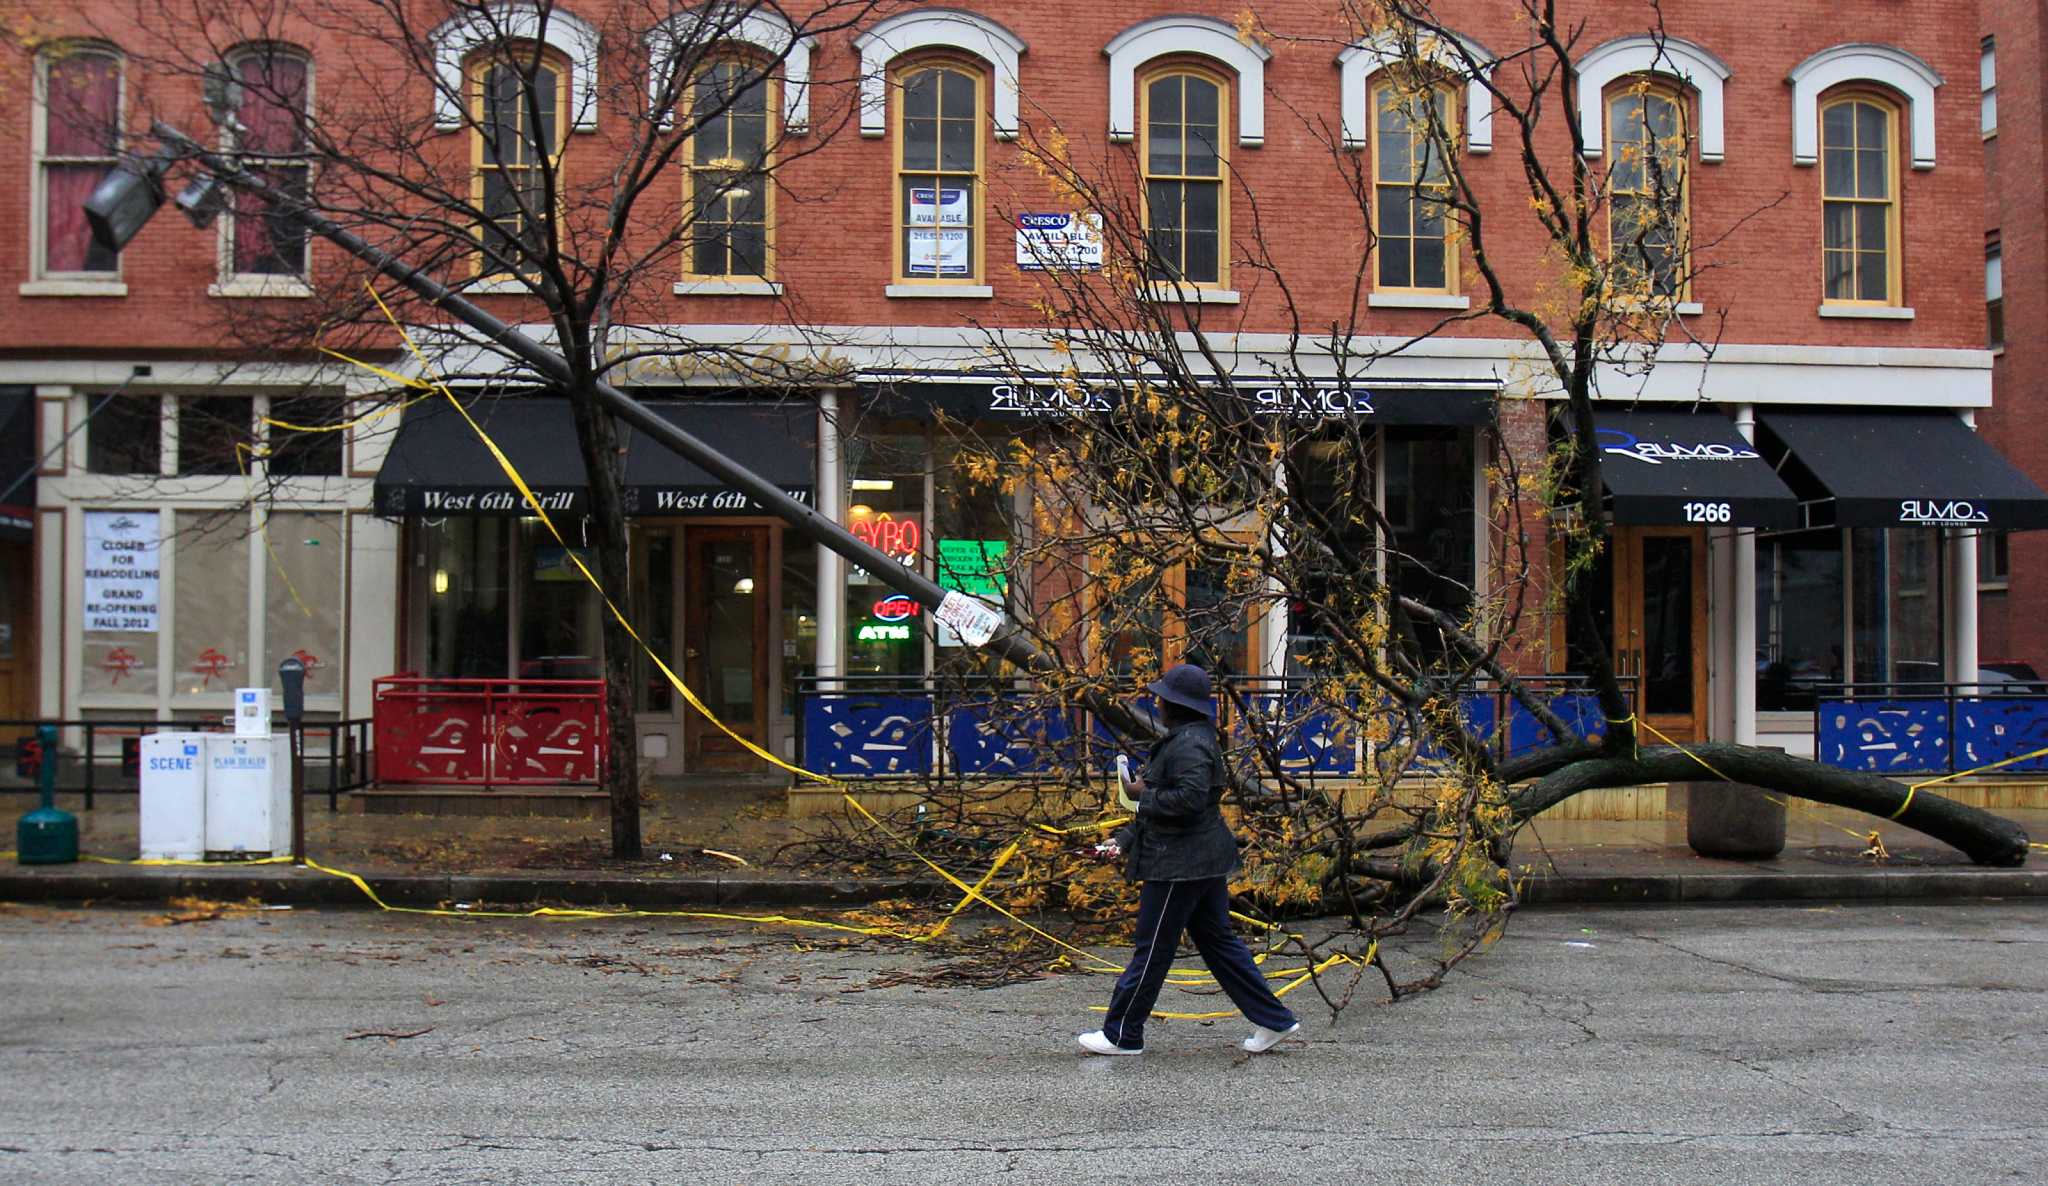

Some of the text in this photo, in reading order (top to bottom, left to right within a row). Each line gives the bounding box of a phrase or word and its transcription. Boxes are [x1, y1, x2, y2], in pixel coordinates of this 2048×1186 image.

[916, 214, 964, 223] AVAIABLE
[424, 491, 475, 510] West
[479, 491, 514, 510] 6th
[656, 491, 708, 509] West
[712, 491, 747, 509] 6th
[1683, 502, 1731, 522] 1266
[850, 520, 918, 553] GYRO
[102, 540, 145, 551] CLOSED
[112, 555, 134, 565] FOR
[85, 570, 159, 579] REMODELING
[102, 589, 143, 600] GRAND
[86, 604, 157, 614] RE-OPENING
[873, 600, 920, 616] OPEN
[94, 618, 149, 628] FALL 2012
[858, 625, 909, 640] ATM
[150, 758, 192, 770] SCENE
